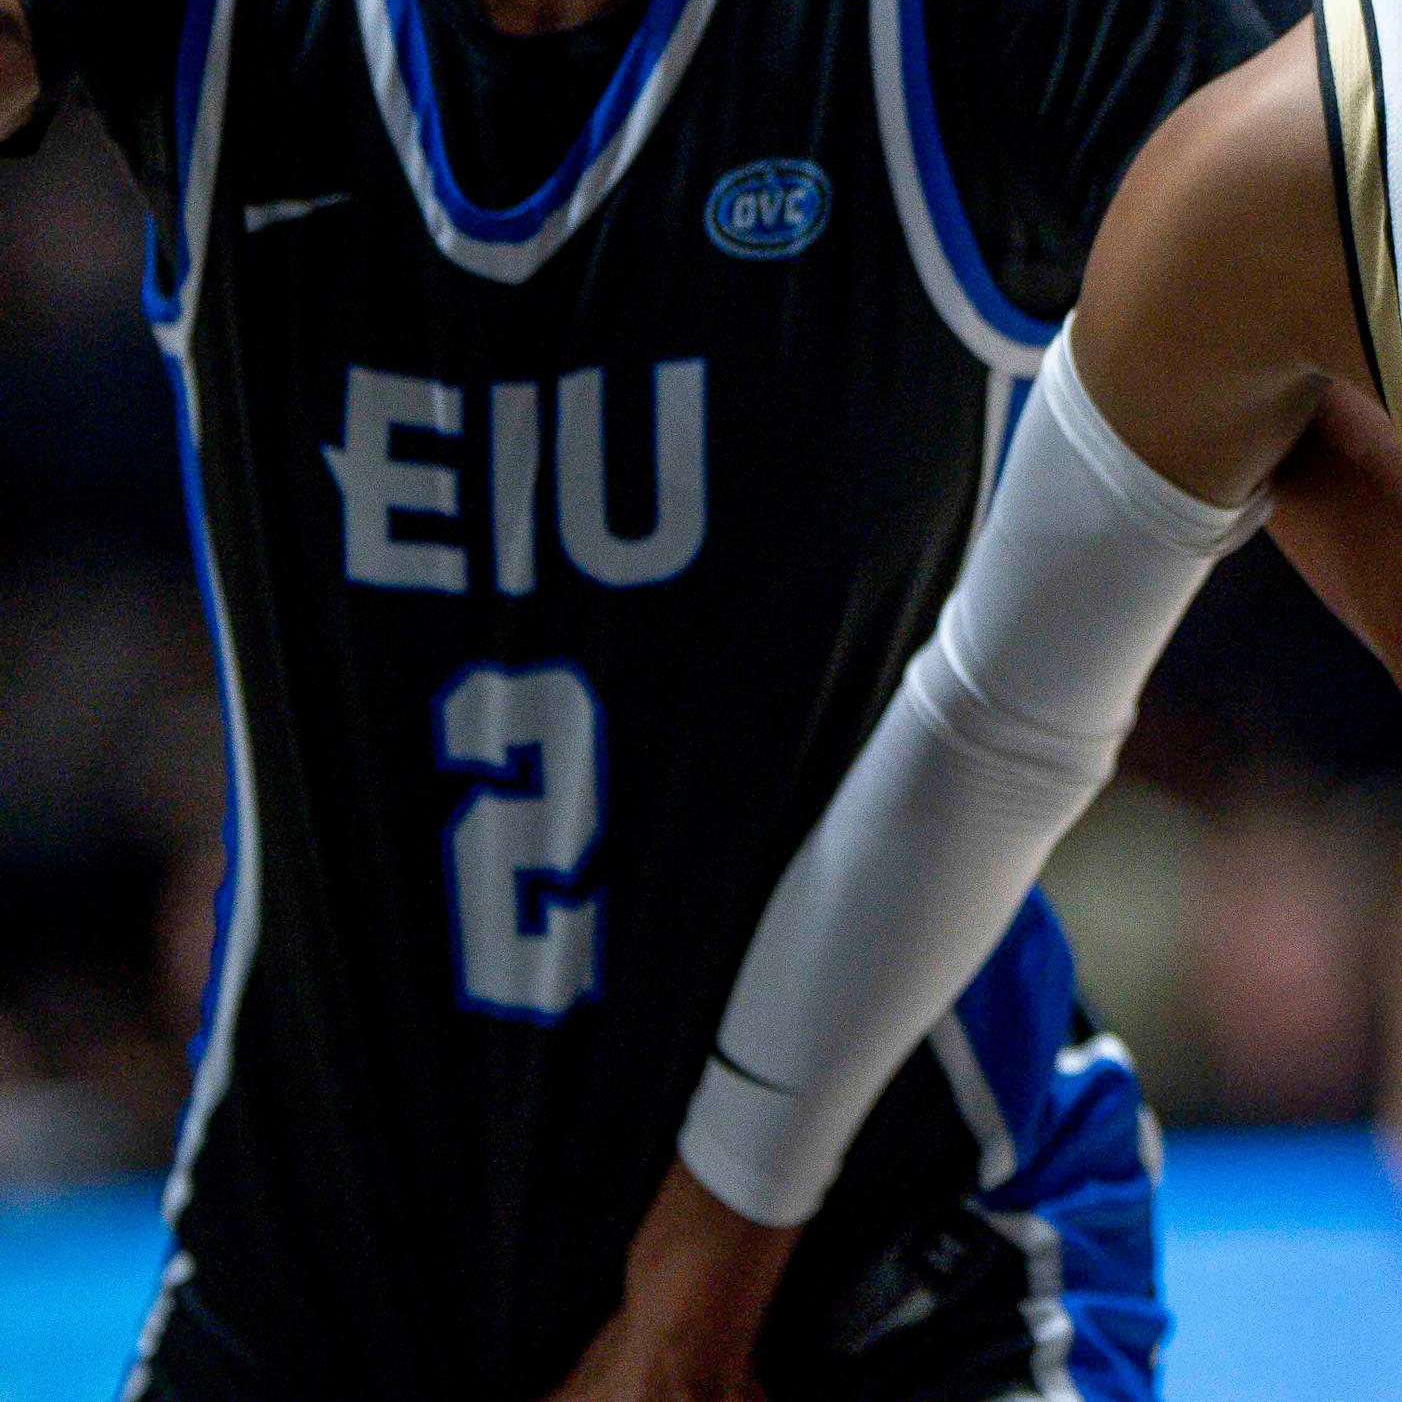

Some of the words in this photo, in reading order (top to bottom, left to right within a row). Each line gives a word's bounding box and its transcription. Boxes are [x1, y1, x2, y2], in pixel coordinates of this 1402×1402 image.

[731, 183, 812, 230] OVC
[320, 355, 710, 598] EIU
[432, 656, 611, 1028] 2
